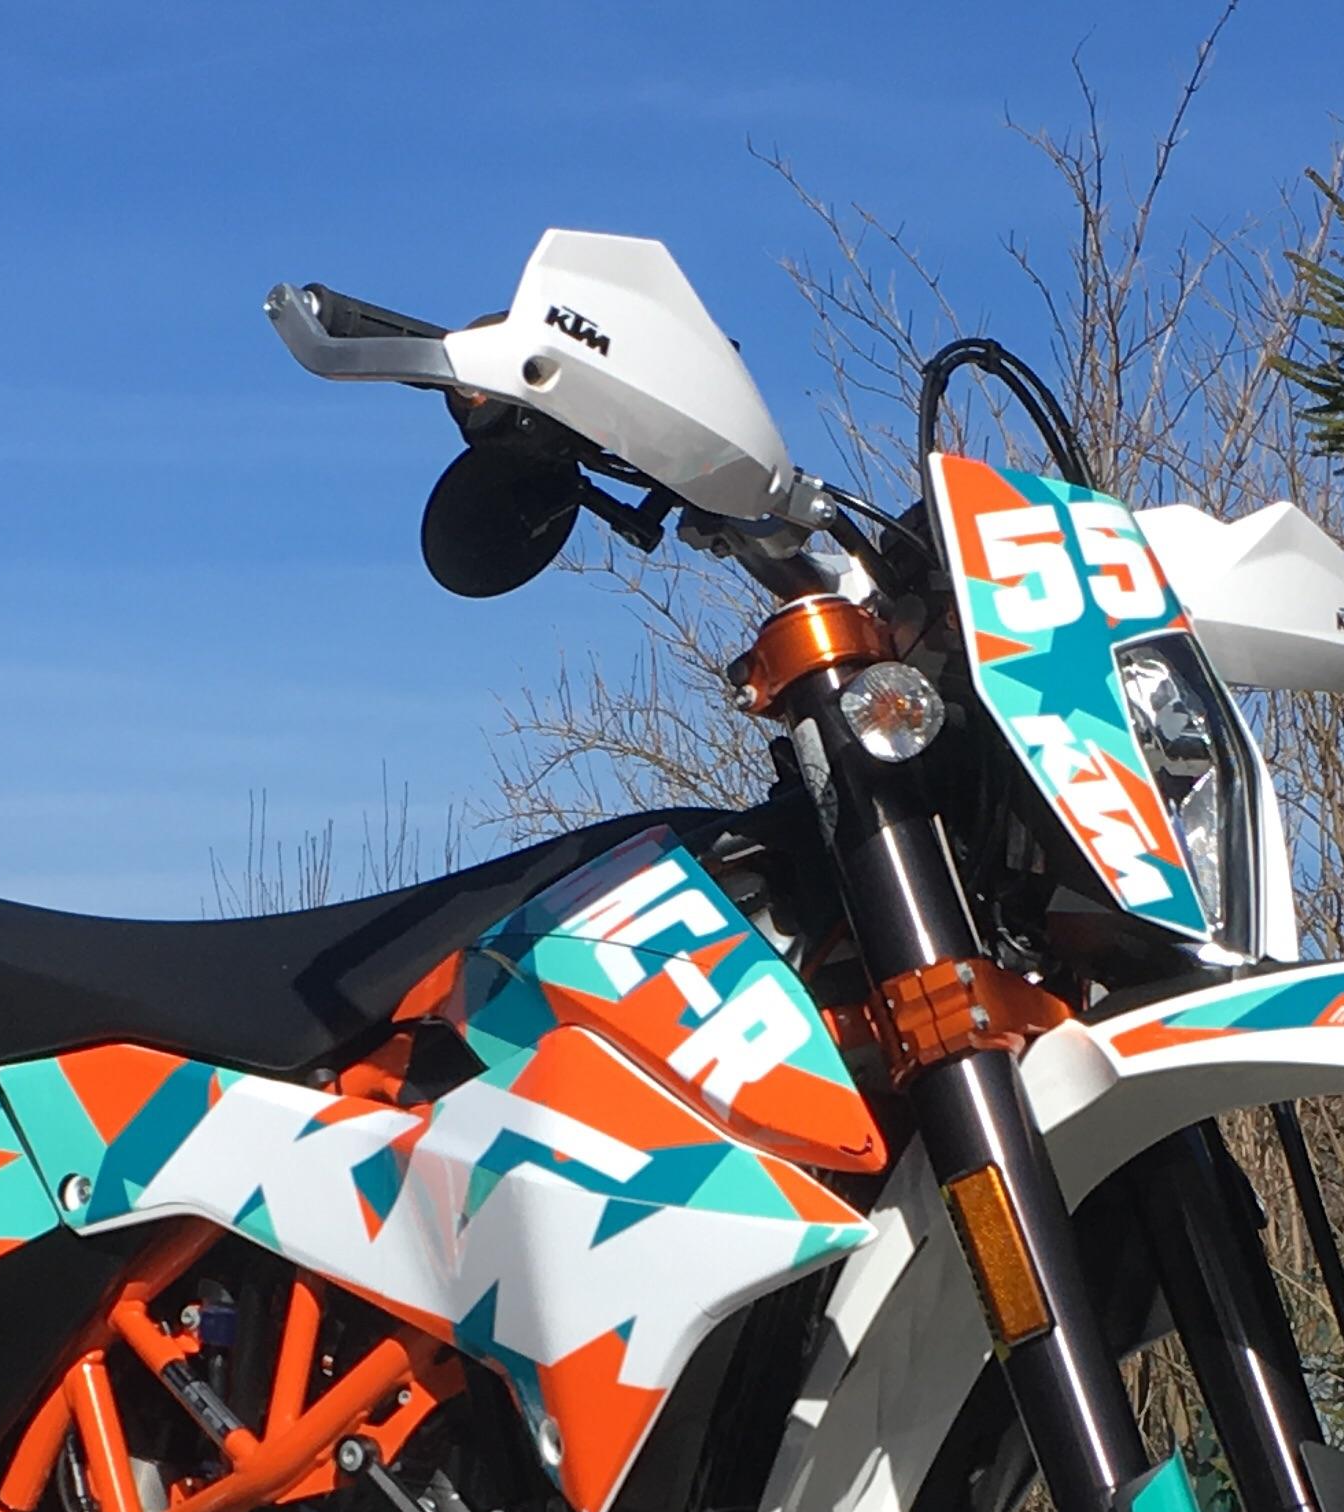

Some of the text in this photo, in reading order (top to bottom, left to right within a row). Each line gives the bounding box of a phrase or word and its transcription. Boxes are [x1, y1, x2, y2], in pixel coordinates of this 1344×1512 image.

[544, 305, 611, 358] KTM
[975, 501, 1167, 633] 55
[1009, 714, 1175, 908] KTM
[137, 1079, 804, 1390] KTM
